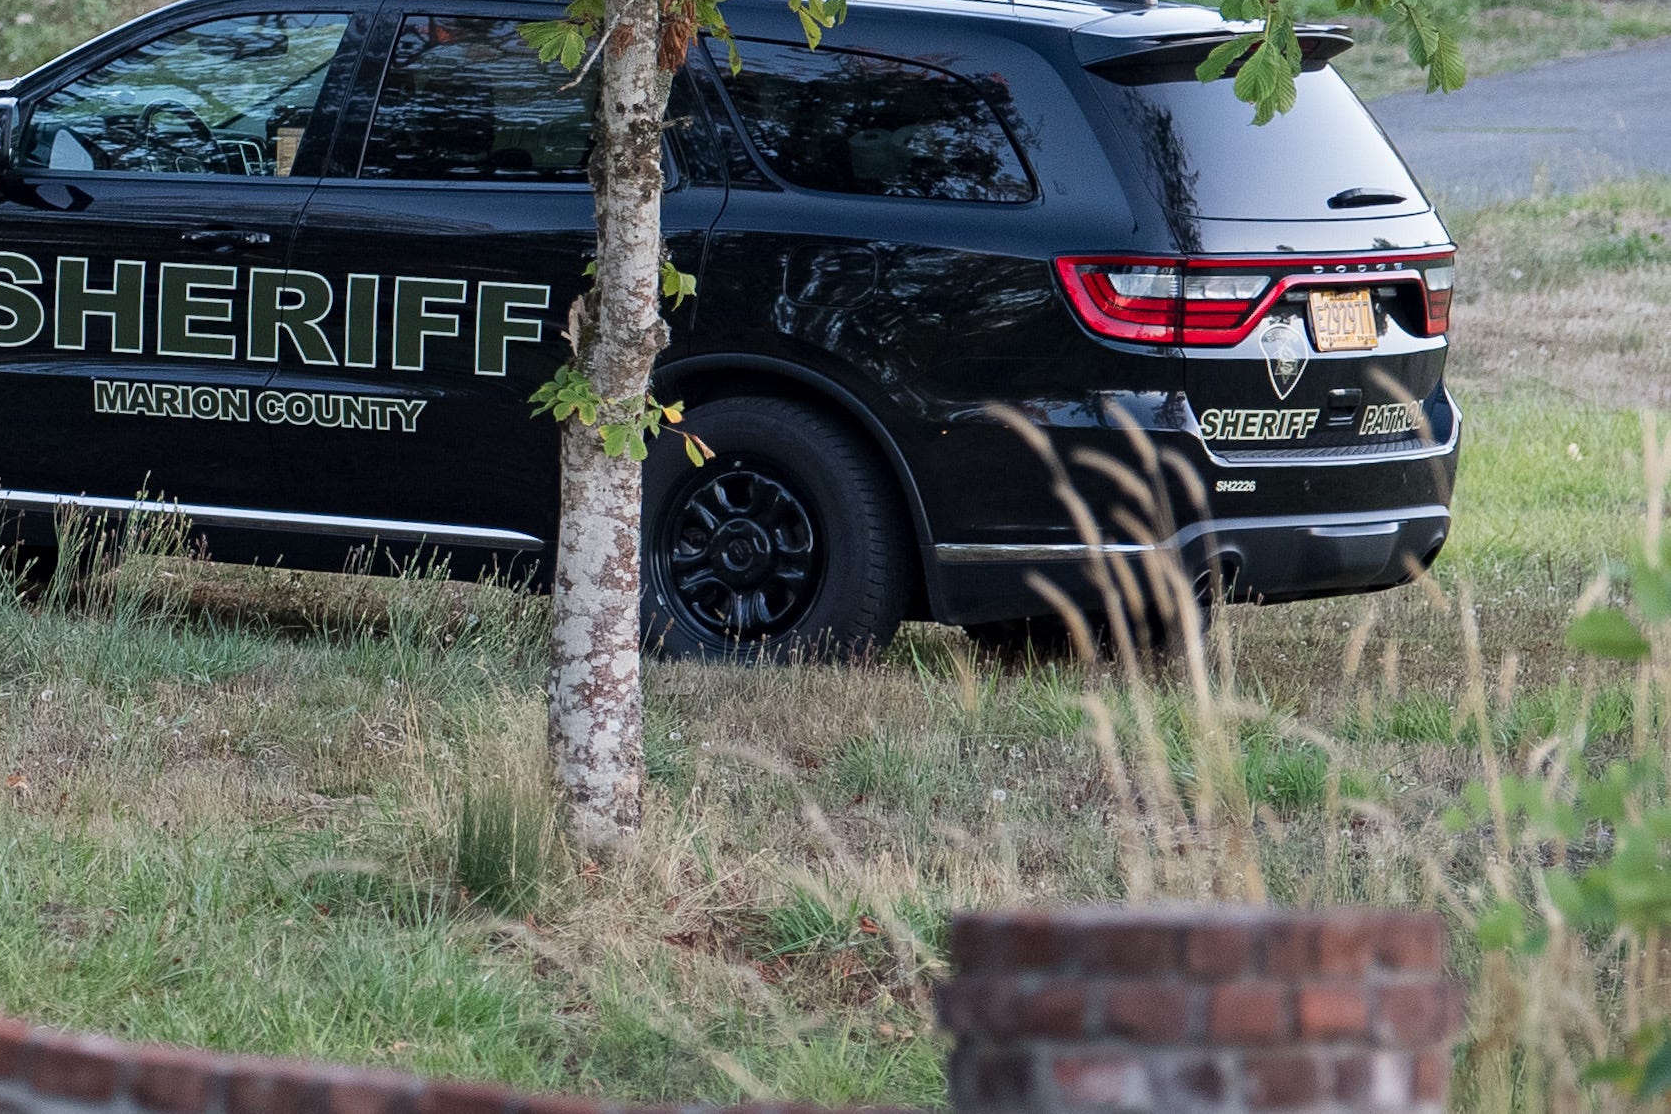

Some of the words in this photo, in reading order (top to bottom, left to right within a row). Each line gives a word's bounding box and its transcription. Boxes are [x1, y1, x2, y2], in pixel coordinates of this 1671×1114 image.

[1312, 262, 1403, 274] DODGE
[93, 380, 250, 423] MARION
[255, 389, 427, 433] COUNTY
[1199, 408, 1321, 441] SHERIFF
[1215, 479, 1257, 493] SH2226
